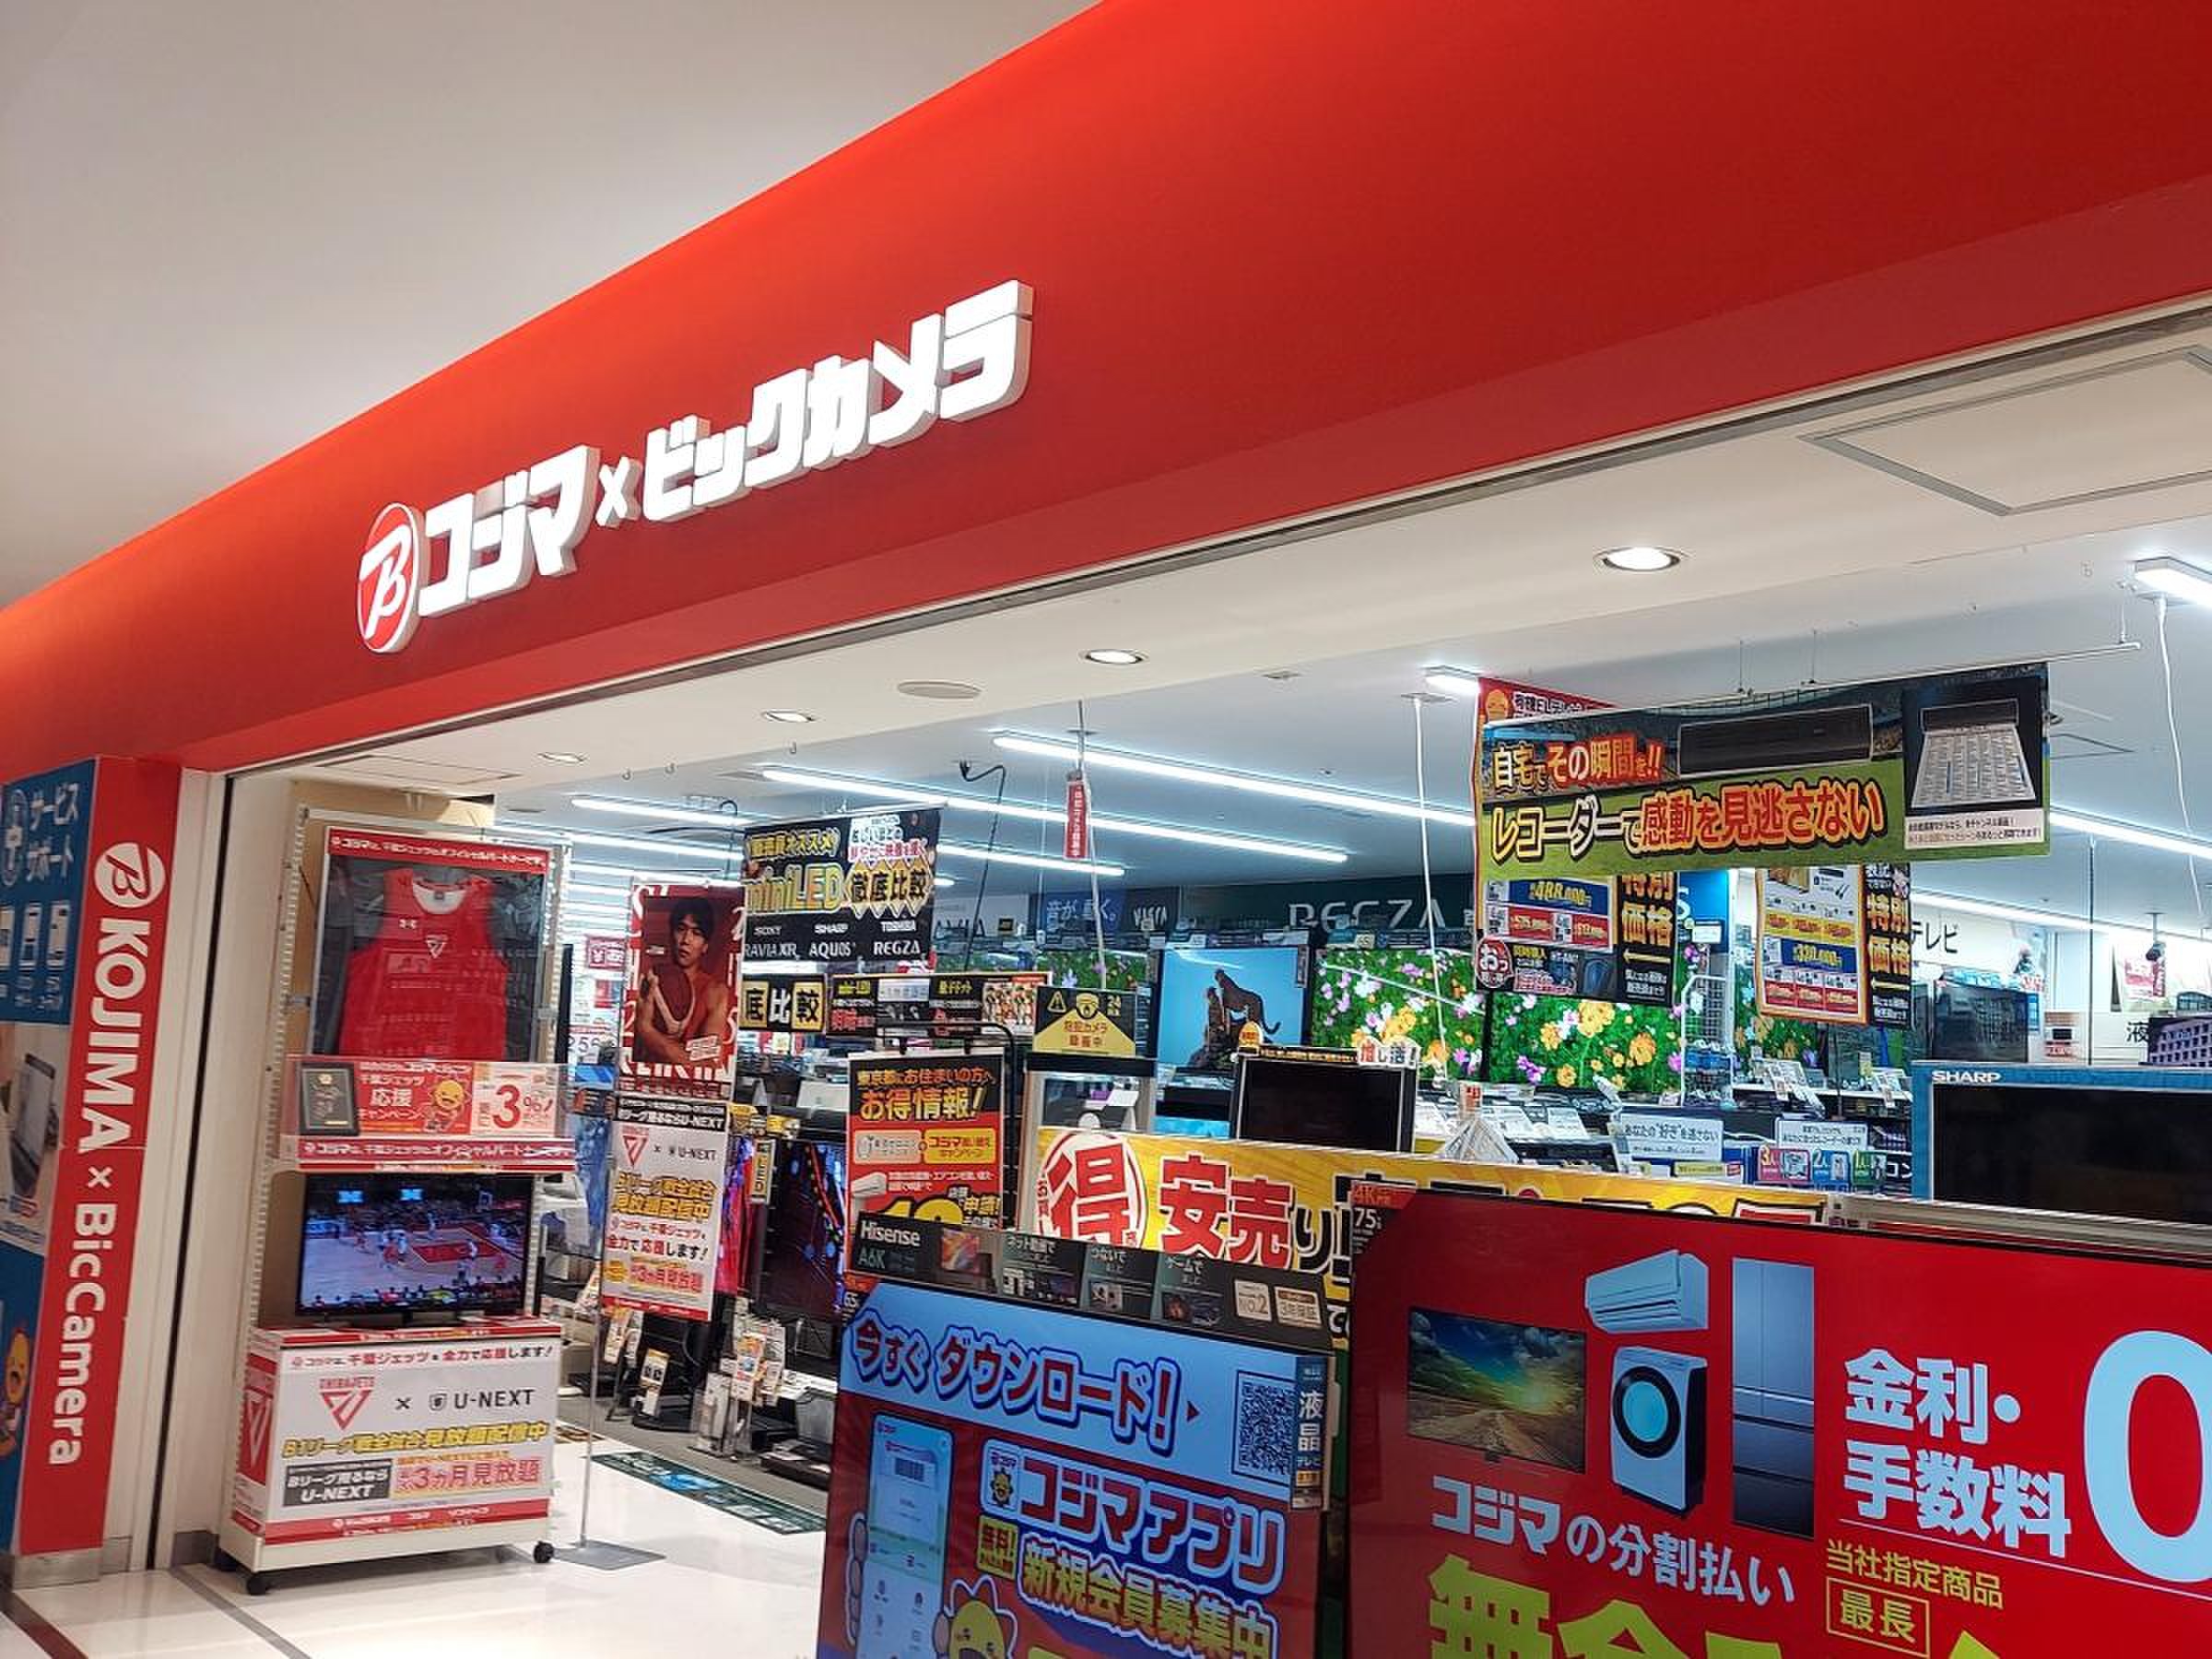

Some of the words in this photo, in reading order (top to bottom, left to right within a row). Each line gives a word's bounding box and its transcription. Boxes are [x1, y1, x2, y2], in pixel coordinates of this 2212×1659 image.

[1491, 782, 1886, 864] レコーダーで感動を見逃さない
[873, 939, 921, 955] REGZA
[78, 917, 150, 1154] KOJIMA
[860, 1087, 988, 1122] お得情報!
[1931, 1071, 2002, 1084] SHARP
[857, 1248, 886, 1269] A6K
[859, 1218, 921, 1247] Hisense
[49, 1203, 118, 1465] BicCamera
[852, 1316, 930, 1389] 今すぐ
[454, 1388, 535, 1410] U-NEXT
[300, 1485, 375, 1503] U-NEXT
[1019, 1454, 1281, 1585] コジマアプリ
[1843, 1439, 2072, 1559] 手数料
[1431, 1474, 1794, 1608] コジマの分割払い
[1825, 1538, 2005, 1609] 当社指定商品
[1023, 1539, 1271, 1659] 新規会員募集中
[1840, 1590, 1917, 1644] 最長
